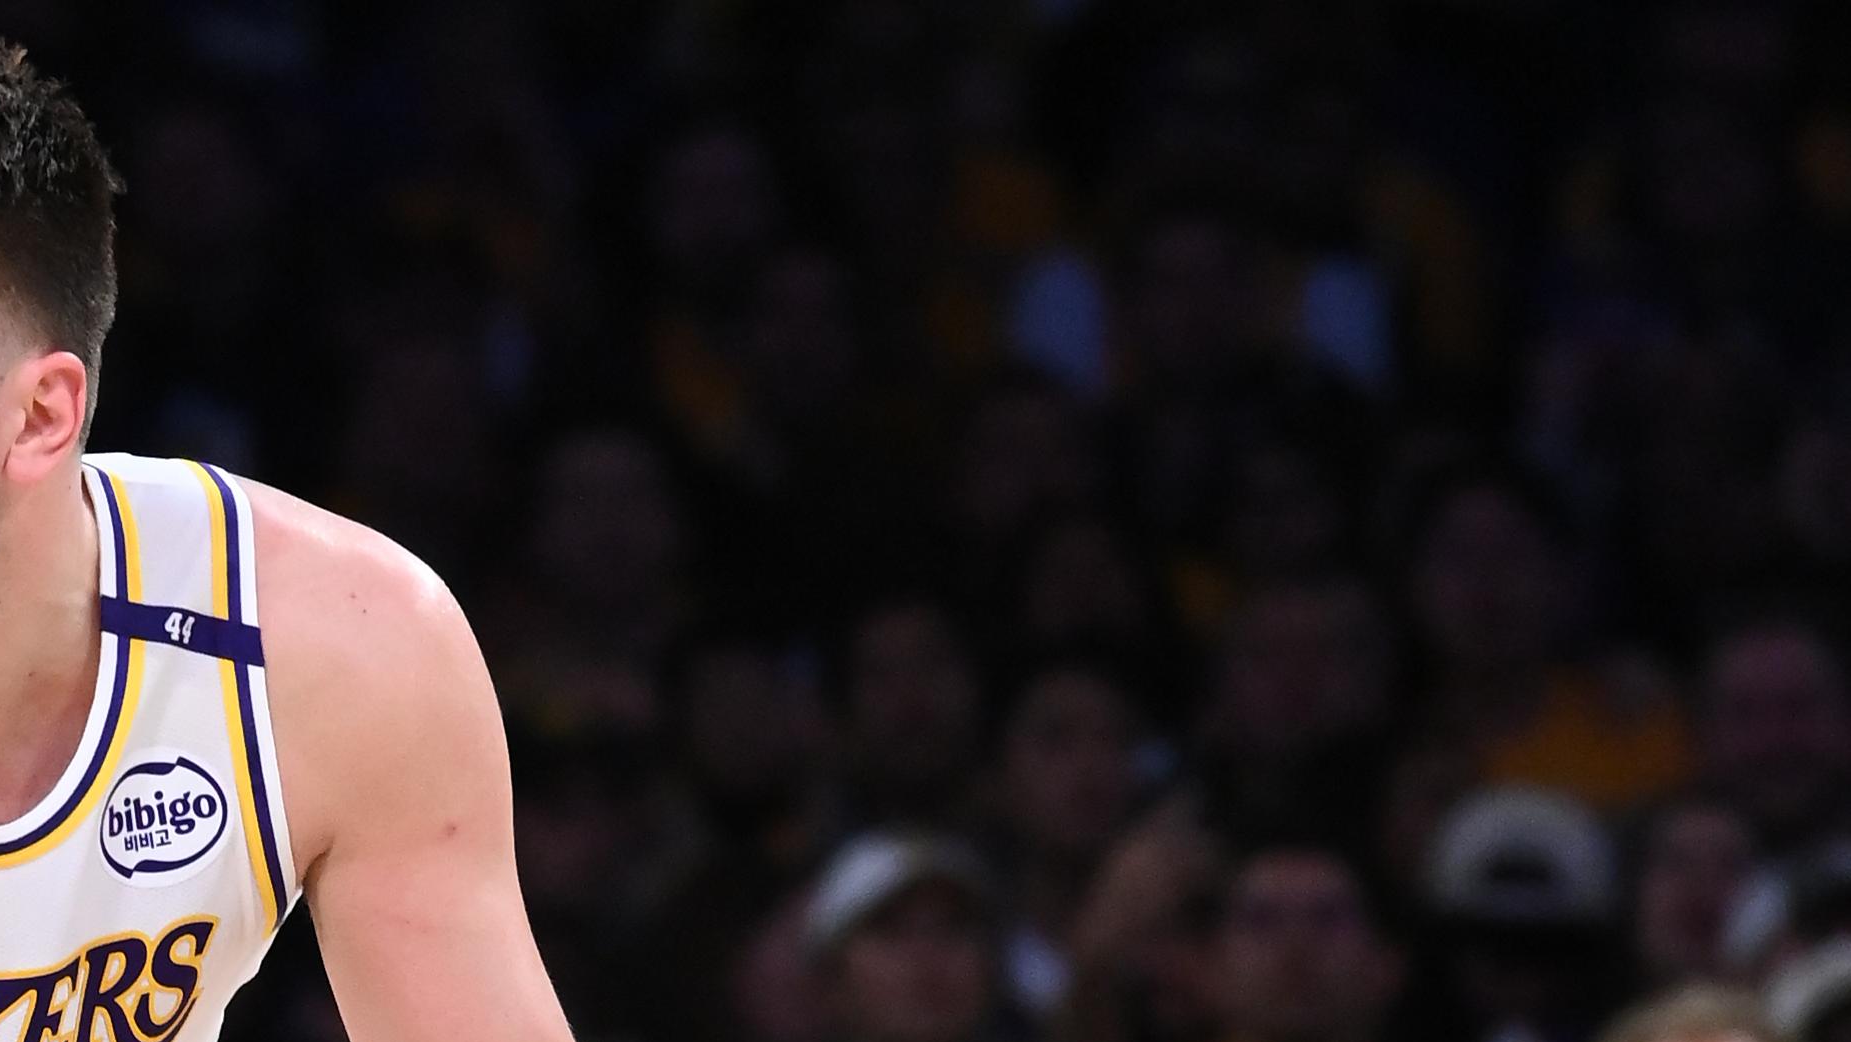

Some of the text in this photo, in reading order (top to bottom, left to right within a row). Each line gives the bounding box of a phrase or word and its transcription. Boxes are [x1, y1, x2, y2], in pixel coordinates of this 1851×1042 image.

[164, 611, 196, 645] 44
[107, 790, 218, 838] bibigo
[123, 828, 173, 853] 비비고
